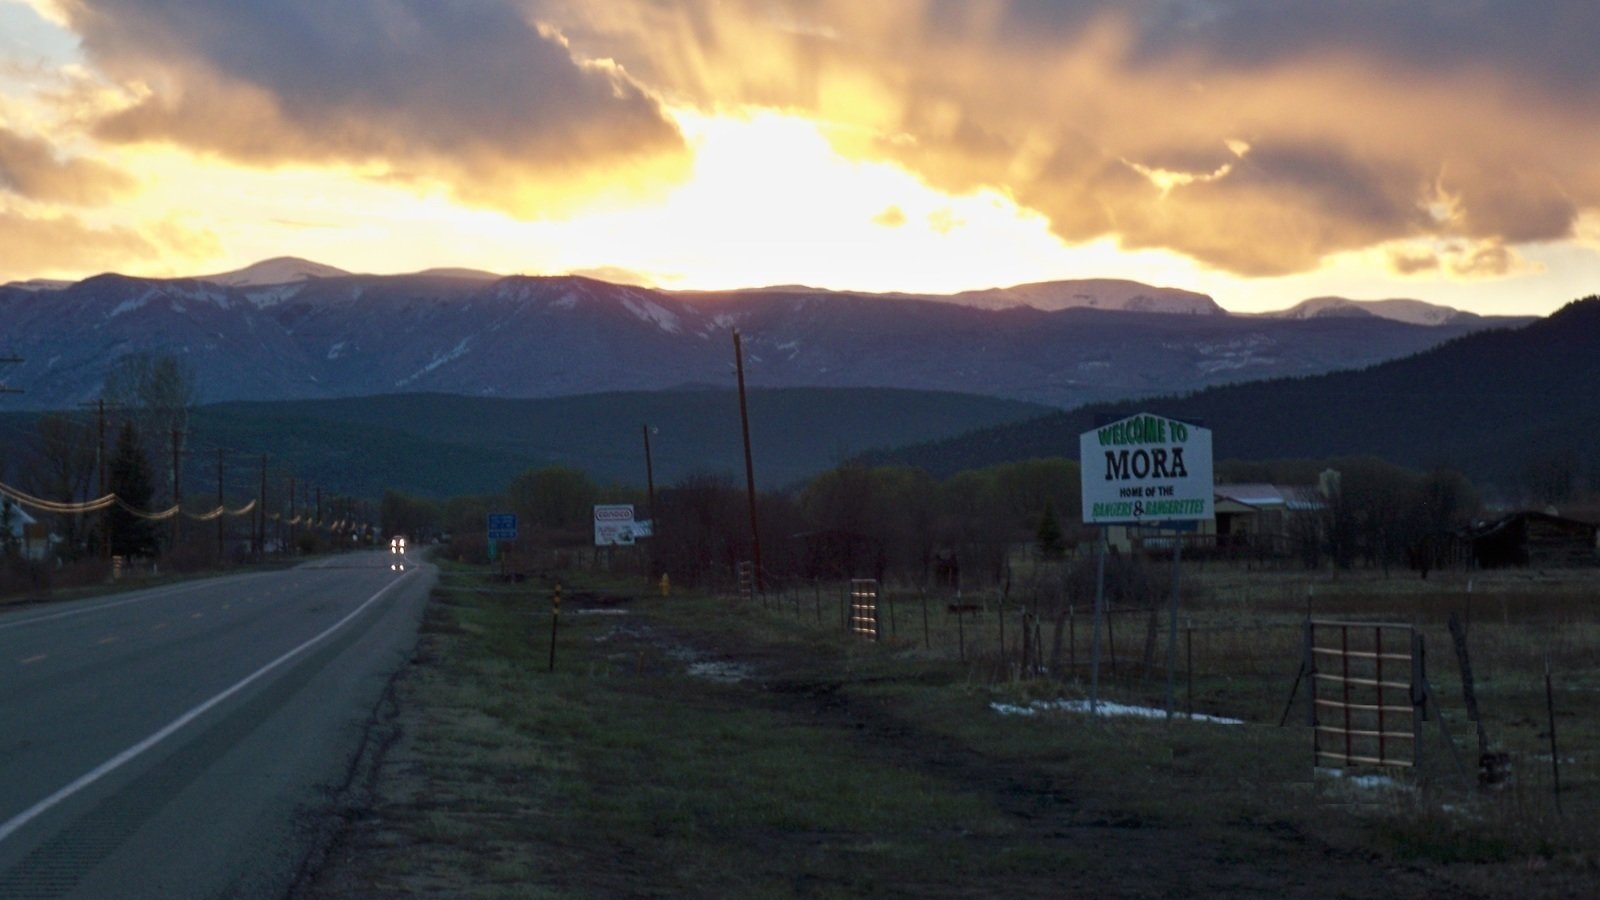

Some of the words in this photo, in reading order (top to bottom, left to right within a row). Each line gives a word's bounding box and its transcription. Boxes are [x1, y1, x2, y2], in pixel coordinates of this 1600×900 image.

[1098, 415, 1166, 446] WELCOME
[1168, 420, 1188, 442] TO
[1105, 447, 1188, 480] MORA
[1120, 486, 1143, 497] HOME
[1145, 486, 1156, 497] OF
[1158, 485, 1174, 496] THE
[1092, 502, 1133, 517] RANGERS
[1133, 500, 1144, 517] &
[1144, 499, 1205, 516] RANGERETTES
